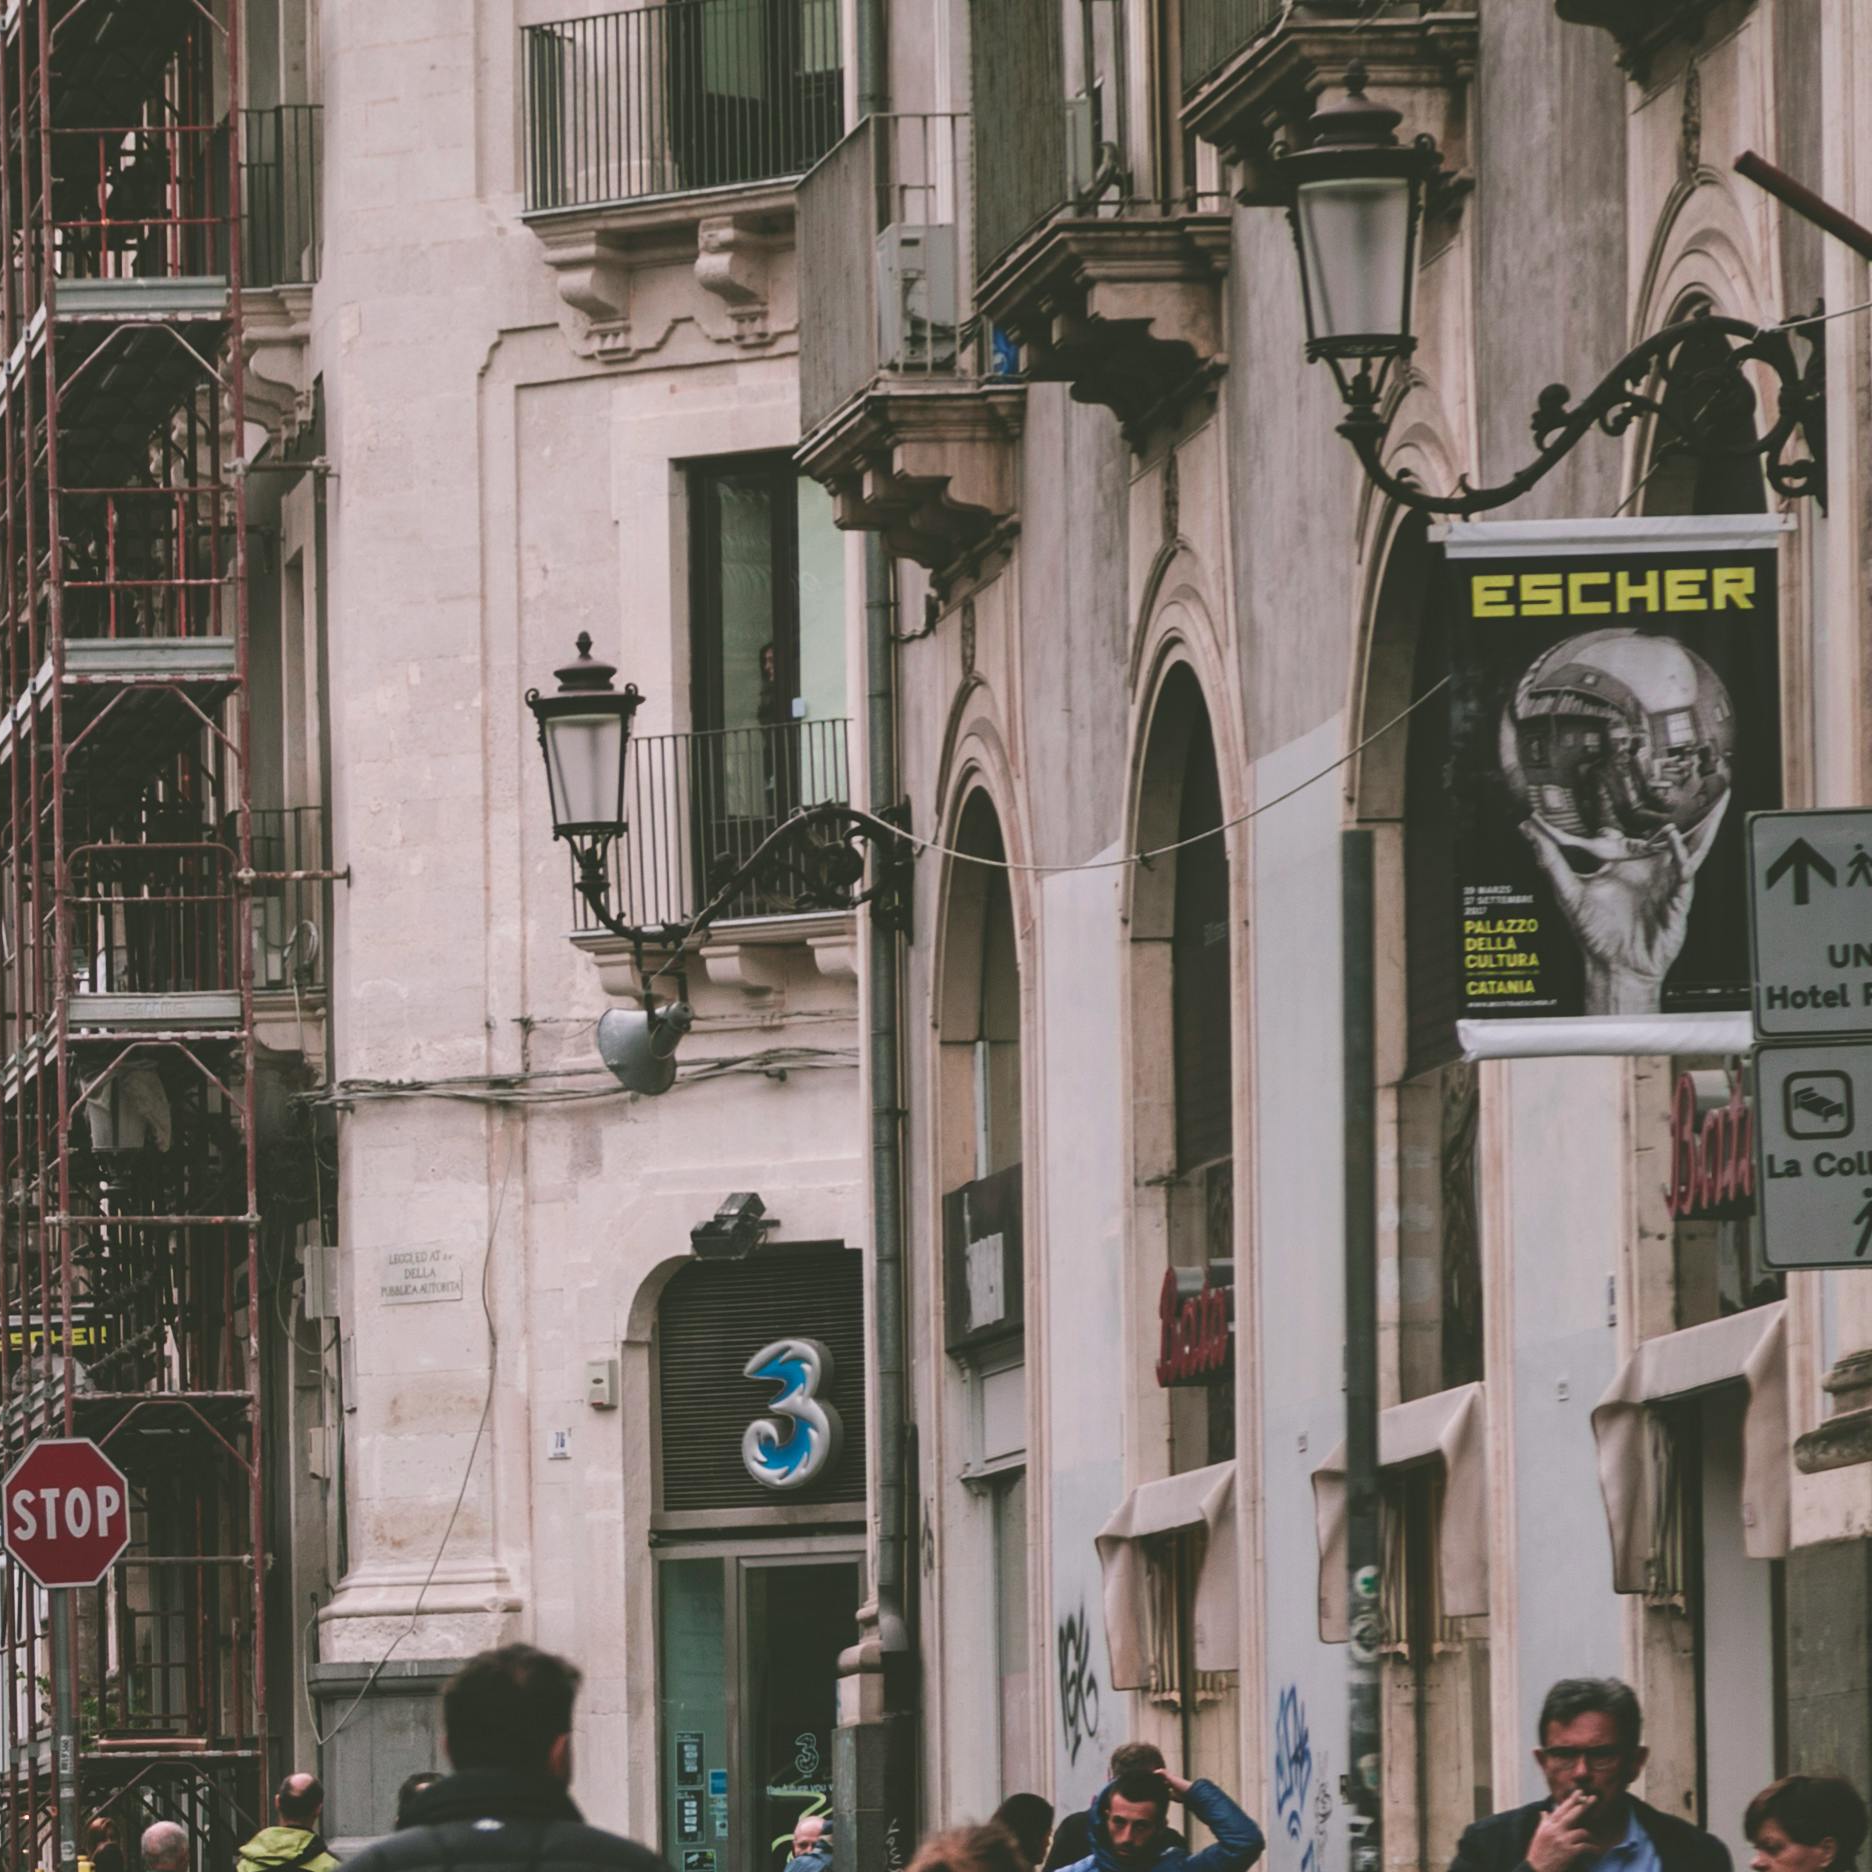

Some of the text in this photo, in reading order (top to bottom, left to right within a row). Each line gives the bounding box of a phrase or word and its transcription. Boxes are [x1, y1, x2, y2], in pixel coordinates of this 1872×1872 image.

[1471, 566, 1754, 618] ESCHER
[1463, 918, 1539, 934] PALAZZO
[1464, 936, 1517, 951] DELLA
[1464, 953, 1540, 968] CULTURA
[1465, 980, 1535, 995] CATANIA
[1766, 983, 1850, 1010] Hotel
[1767, 1153, 1802, 1179] La
[404, 1267, 436, 1280] DELLA
[742, 1339, 834, 1489] 3
[12, 1485, 121, 1541] STOP
